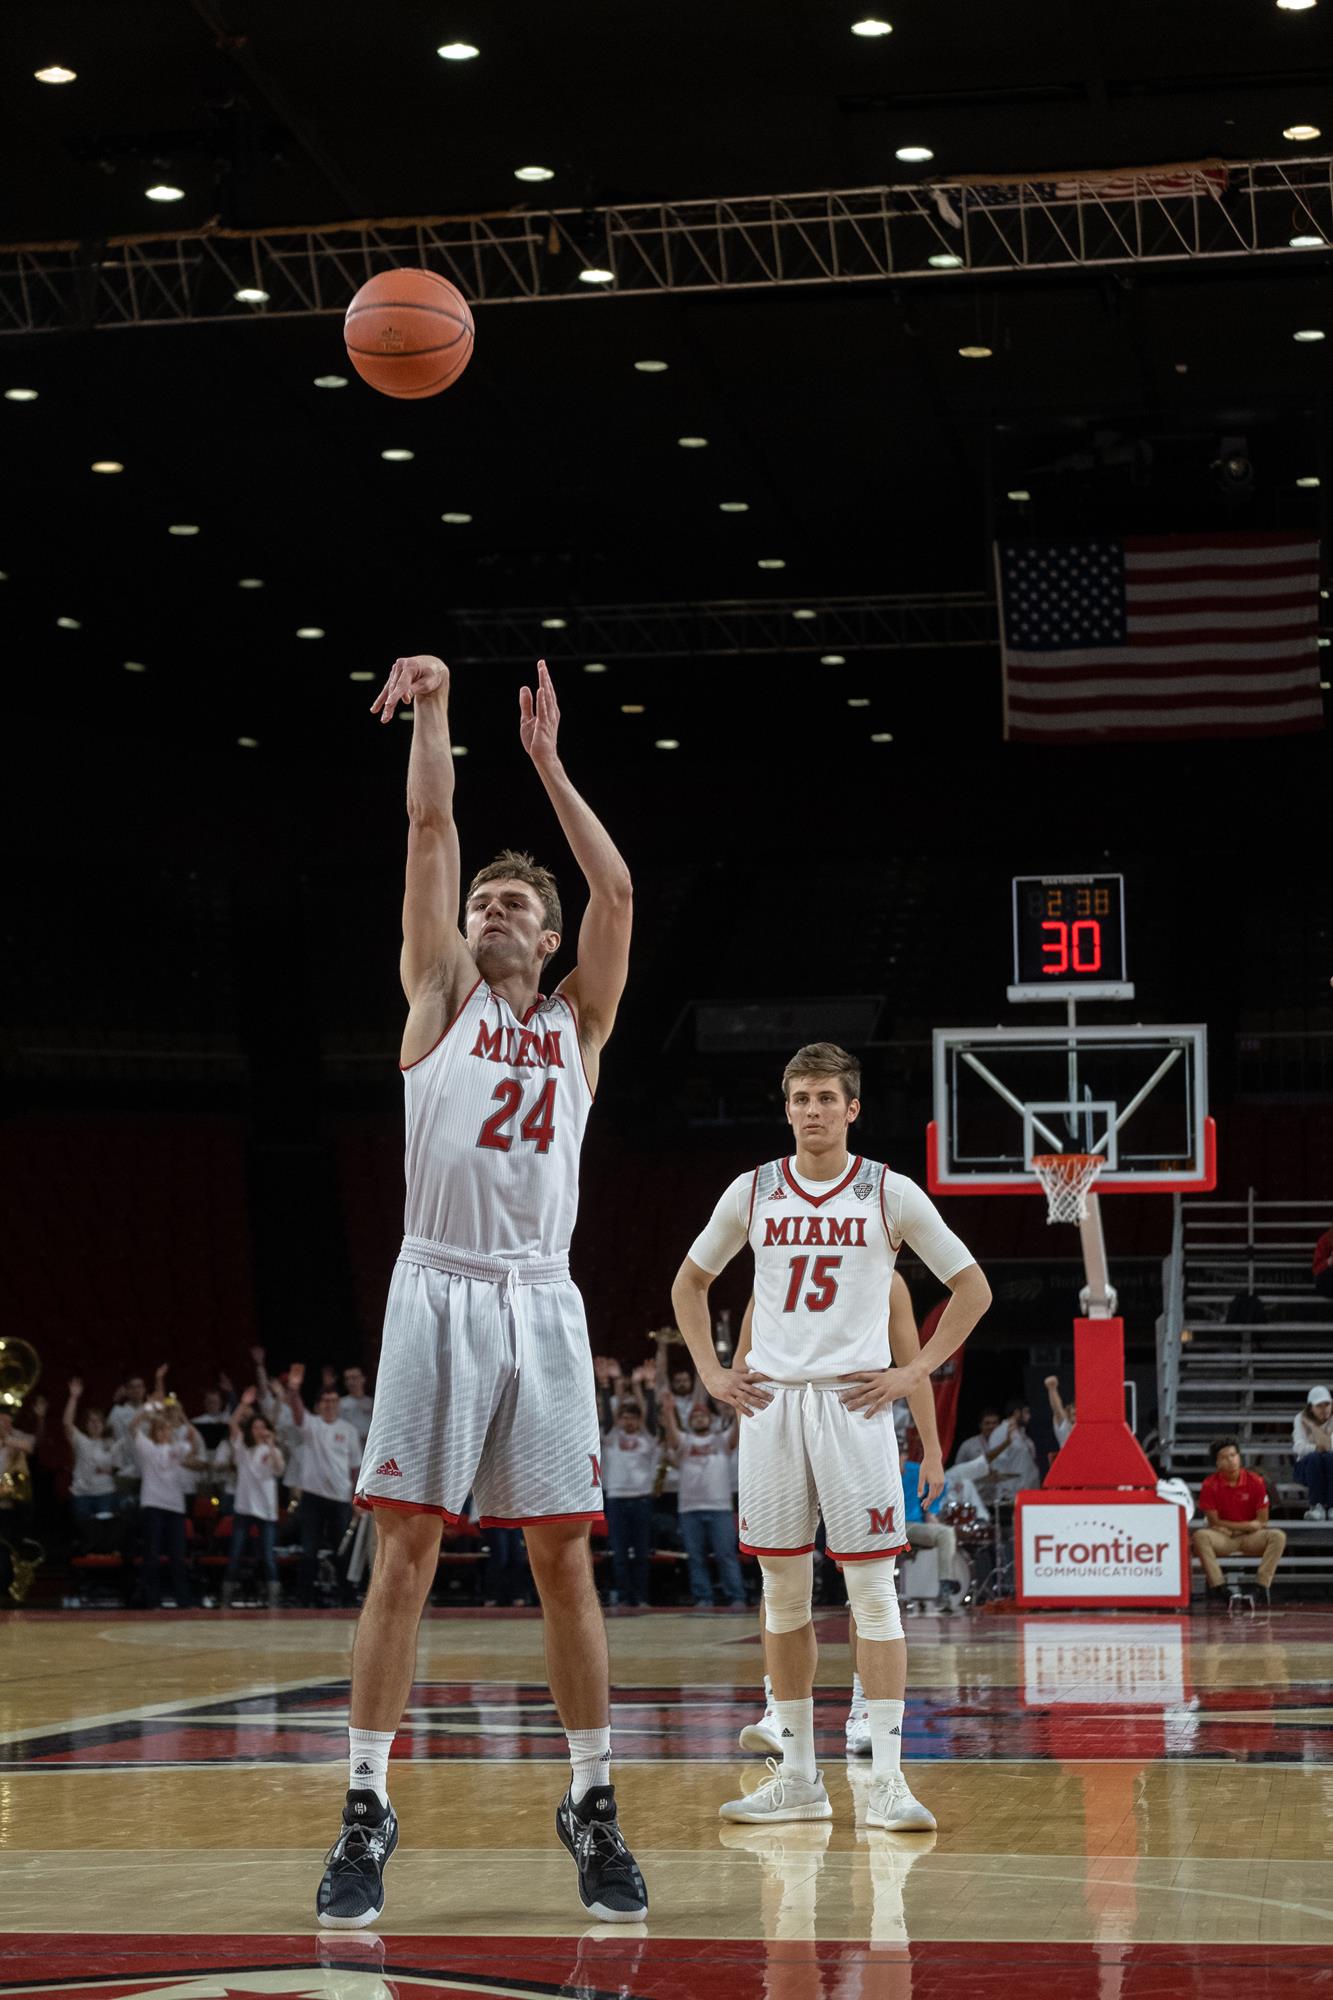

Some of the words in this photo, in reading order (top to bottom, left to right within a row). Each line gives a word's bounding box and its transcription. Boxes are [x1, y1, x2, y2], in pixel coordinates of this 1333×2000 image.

[1041, 919, 1101, 974] 30
[475, 1077, 558, 1154] 24
[762, 1216, 868, 1247] MIAMI
[782, 1254, 843, 1313] 15
[376, 1468, 403, 1477] adidas
[866, 1506, 896, 1535] M
[1034, 1535, 1169, 1564] Frontier
[1034, 1566, 1164, 1577] COMMUNICATIONS
